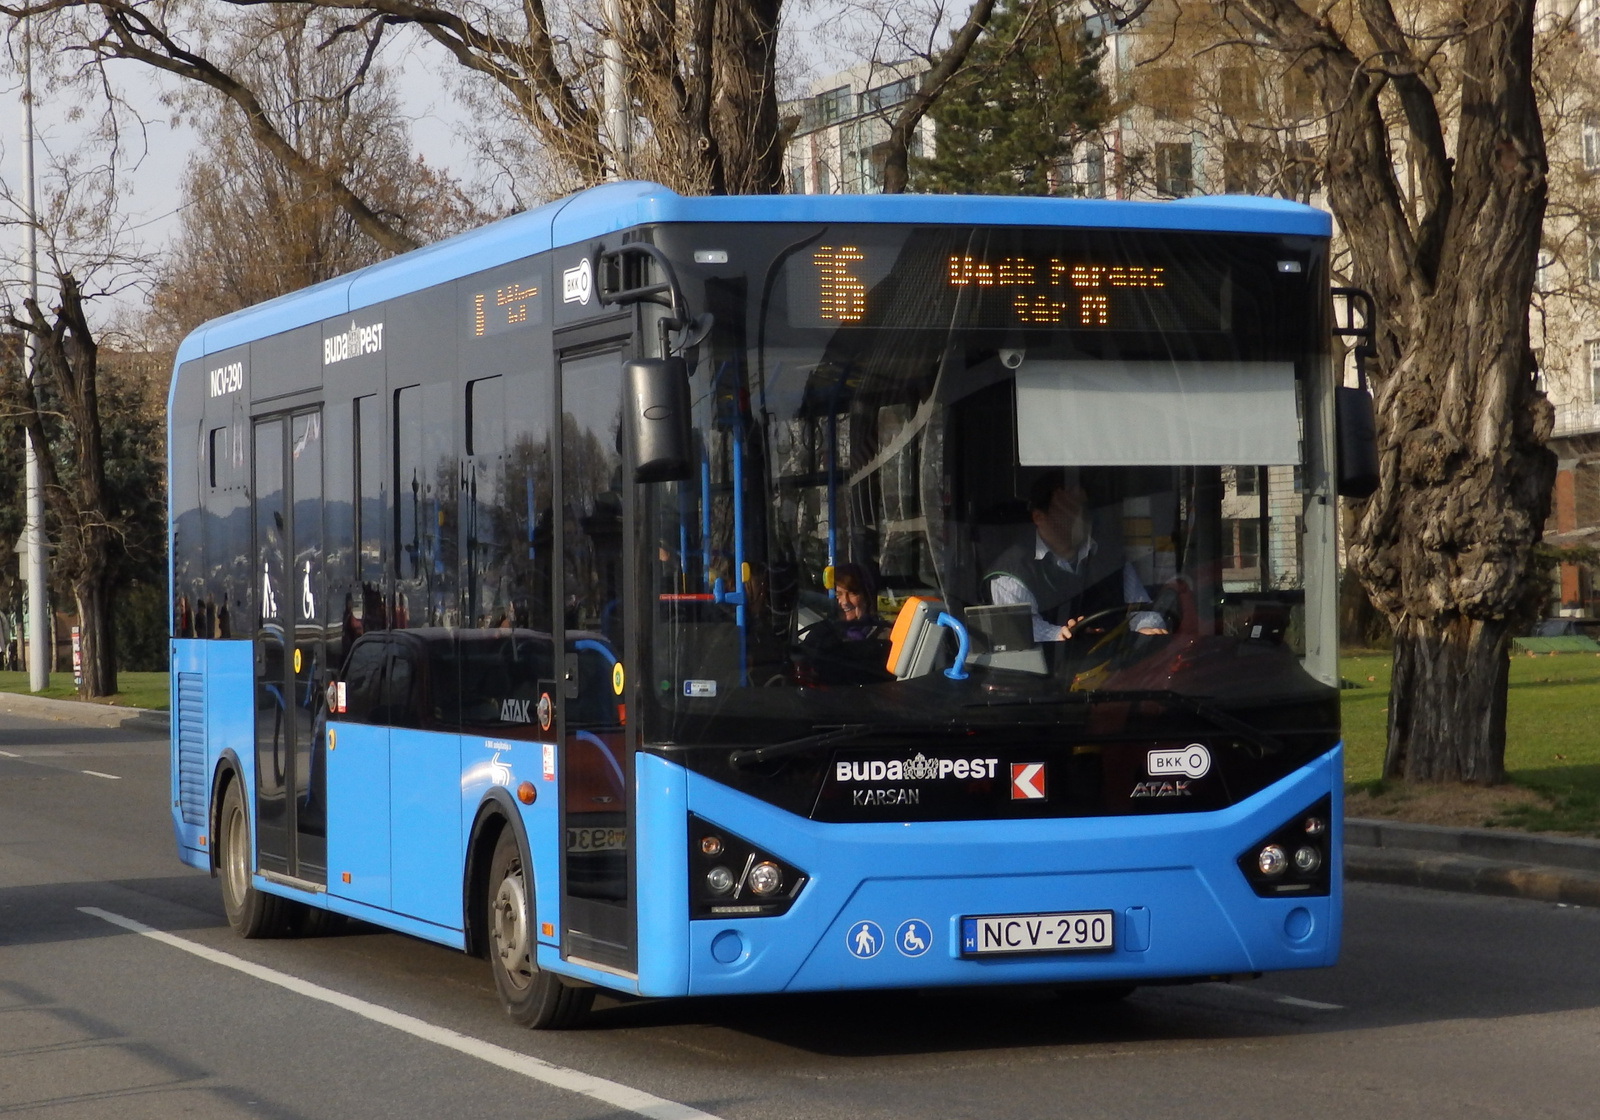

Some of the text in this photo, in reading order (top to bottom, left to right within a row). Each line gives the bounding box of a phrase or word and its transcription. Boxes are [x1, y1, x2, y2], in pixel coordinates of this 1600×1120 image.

[814, 246, 865, 319] 16
[210, 362, 243, 398] NCV-290
[501, 698, 531, 723] ATAK
[1156, 757, 1182, 768] BKK
[853, 788, 919, 806] KARSAN
[1130, 780, 1192, 798] ATAK
[966, 917, 1106, 948] H NCV-290
